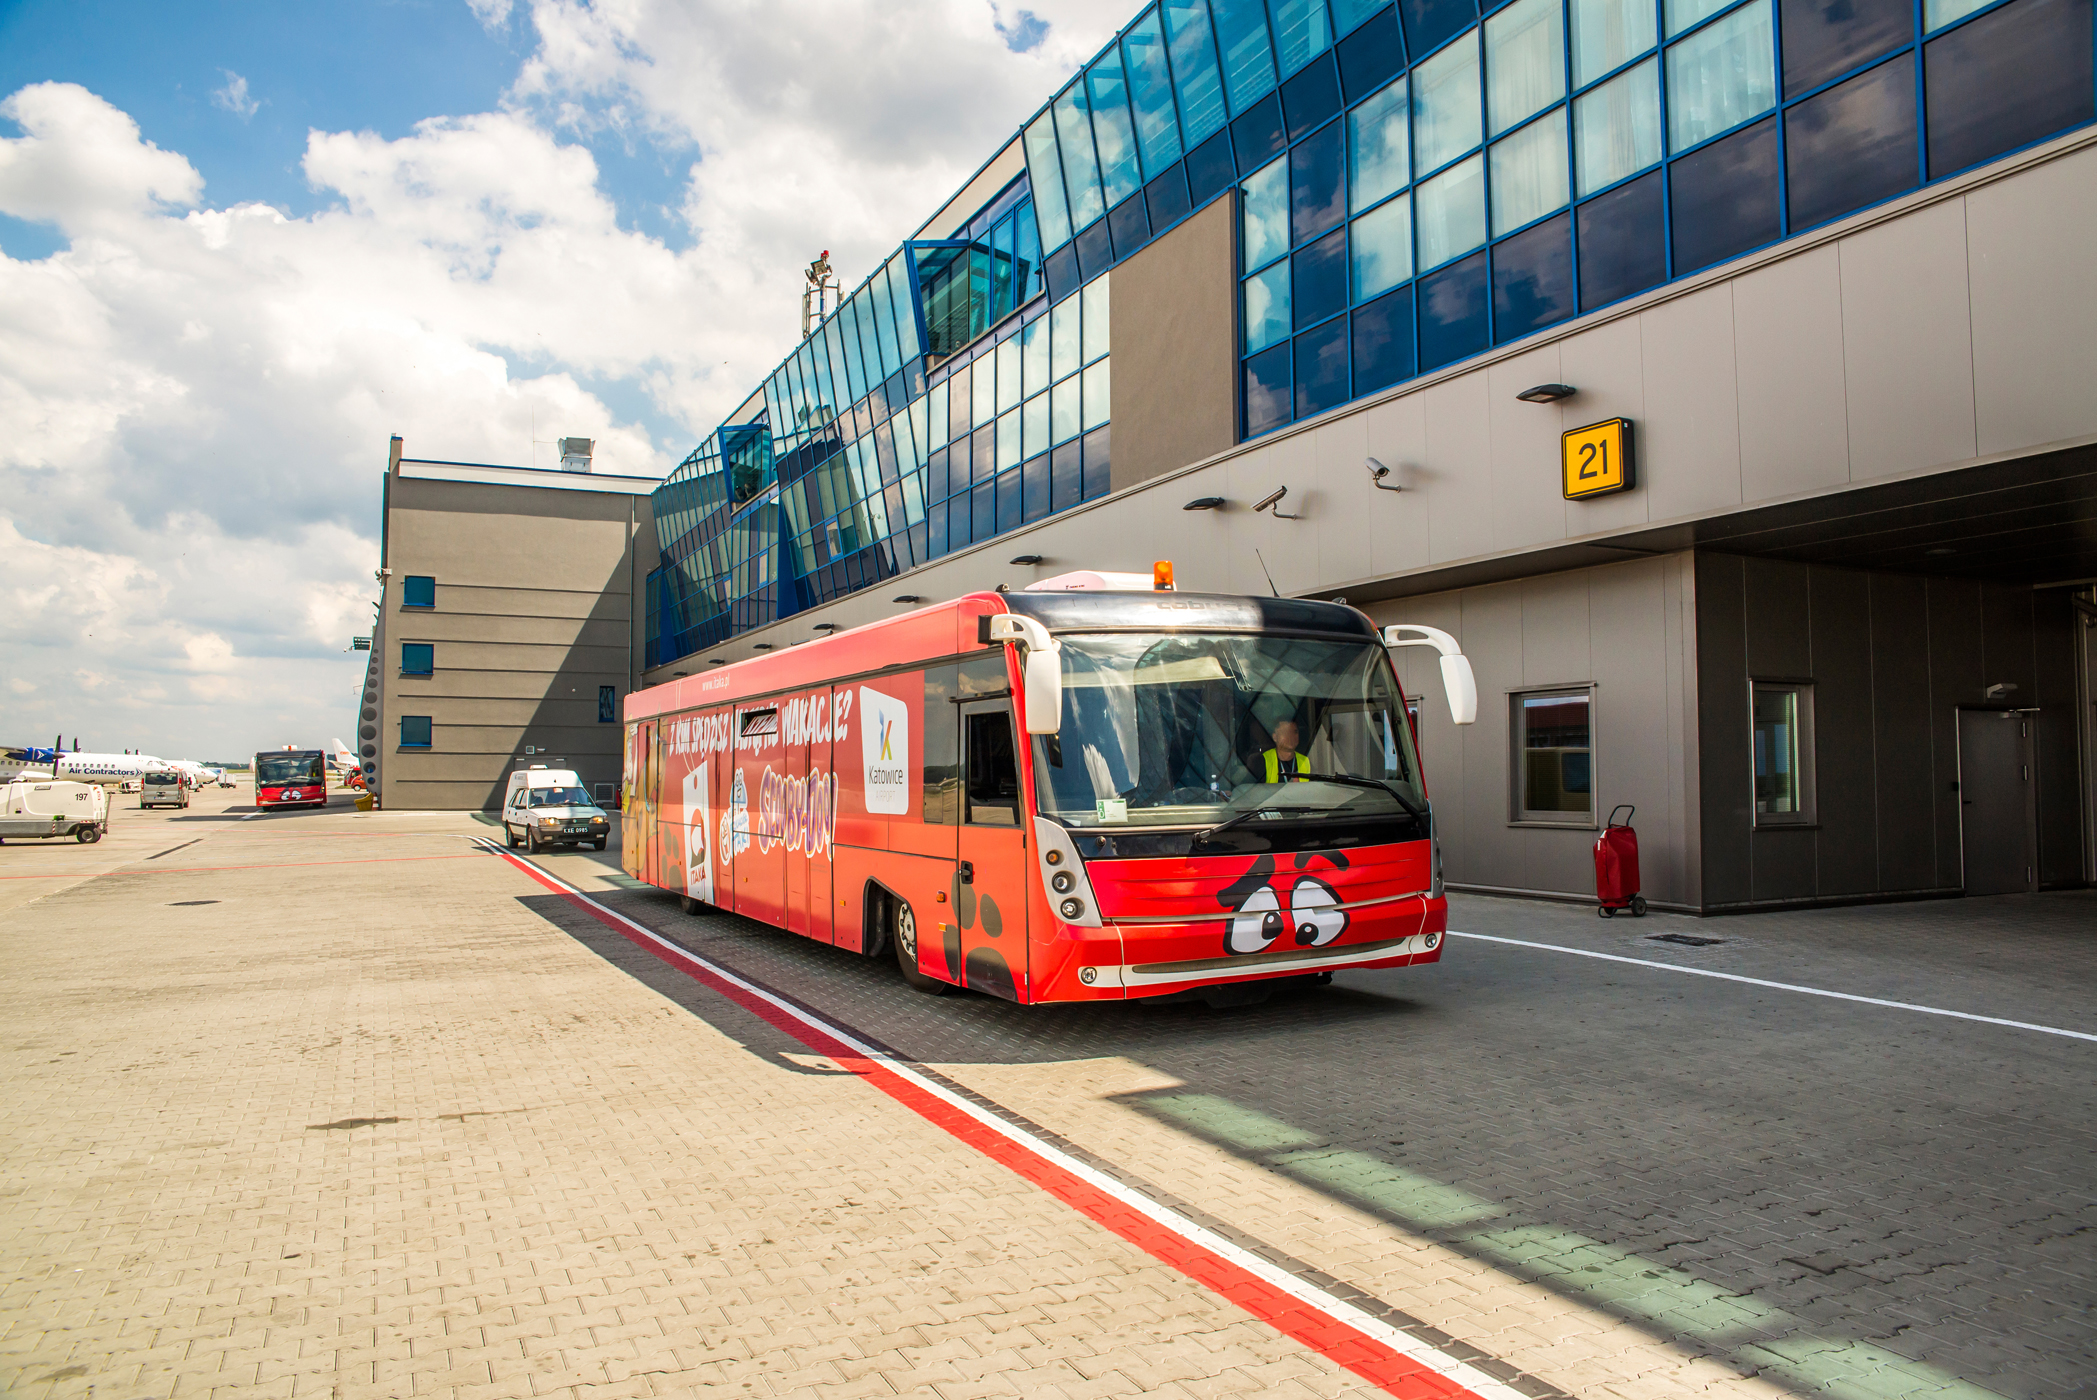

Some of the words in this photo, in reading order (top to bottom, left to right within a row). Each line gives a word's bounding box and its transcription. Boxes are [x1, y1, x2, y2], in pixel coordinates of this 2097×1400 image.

[1578, 439, 1608, 480] 21
[702, 672, 730, 691] www.itaka.pl
[669, 721, 676, 757] Z
[782, 690, 853, 748] WAKACJE?
[83, 767, 135, 776] Contractors
[868, 765, 904, 785] Katowice
[75, 793, 88, 801] 197
[690, 864, 707, 885] ITAKA
